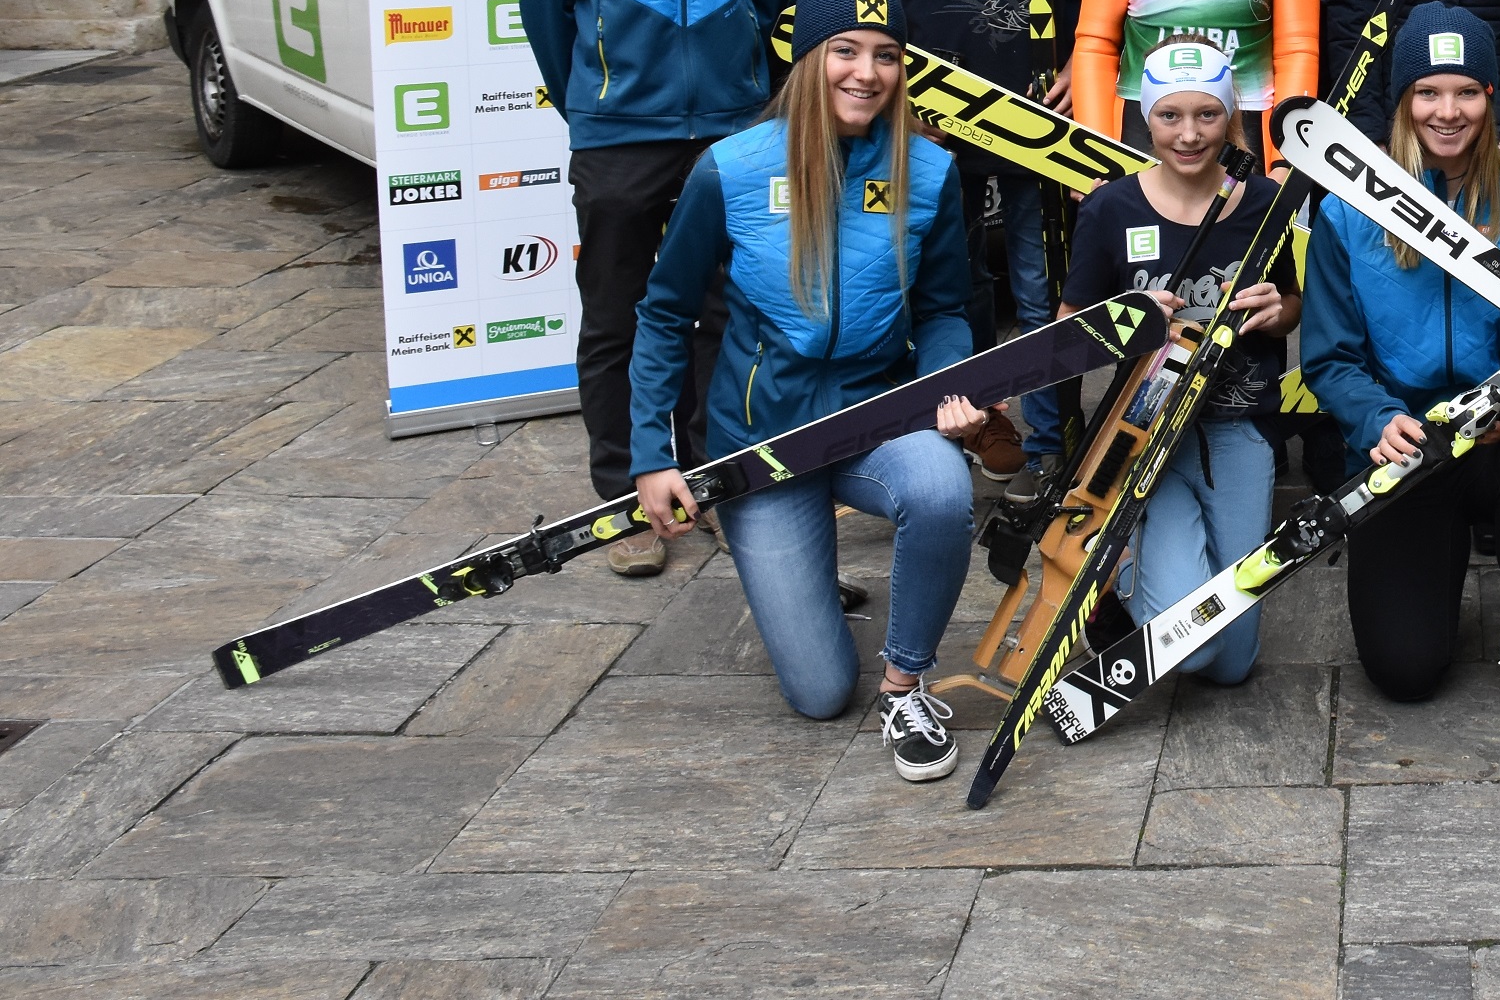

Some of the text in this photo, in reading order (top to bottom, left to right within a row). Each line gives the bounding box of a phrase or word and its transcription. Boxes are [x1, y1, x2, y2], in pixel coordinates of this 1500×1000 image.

[388, 12, 449, 40] Murauer
[482, 90, 533, 102] Raiffeisen
[402, 87, 443, 127] E
[475, 101, 533, 114] Meine Bank
[941, 117, 994, 146] EAGLE
[1234, 153, 1253, 179] STEYR
[391, 172, 459, 187] STEIERMARK
[488, 170, 558, 189] giga sport
[392, 184, 460, 203] JOKER
[1324, 142, 1471, 260] HEAD
[502, 242, 540, 275] K1
[407, 270, 454, 286] UNIQA
[398, 331, 451, 344] Raiffeisen
[488, 319, 545, 340] Steiermark
[507, 331, 527, 340] SPORT
[1073, 316, 1126, 360] FISCHER
[391, 341, 451, 356] Meine Bank
[1013, 579, 1099, 752] CARBON LITE
